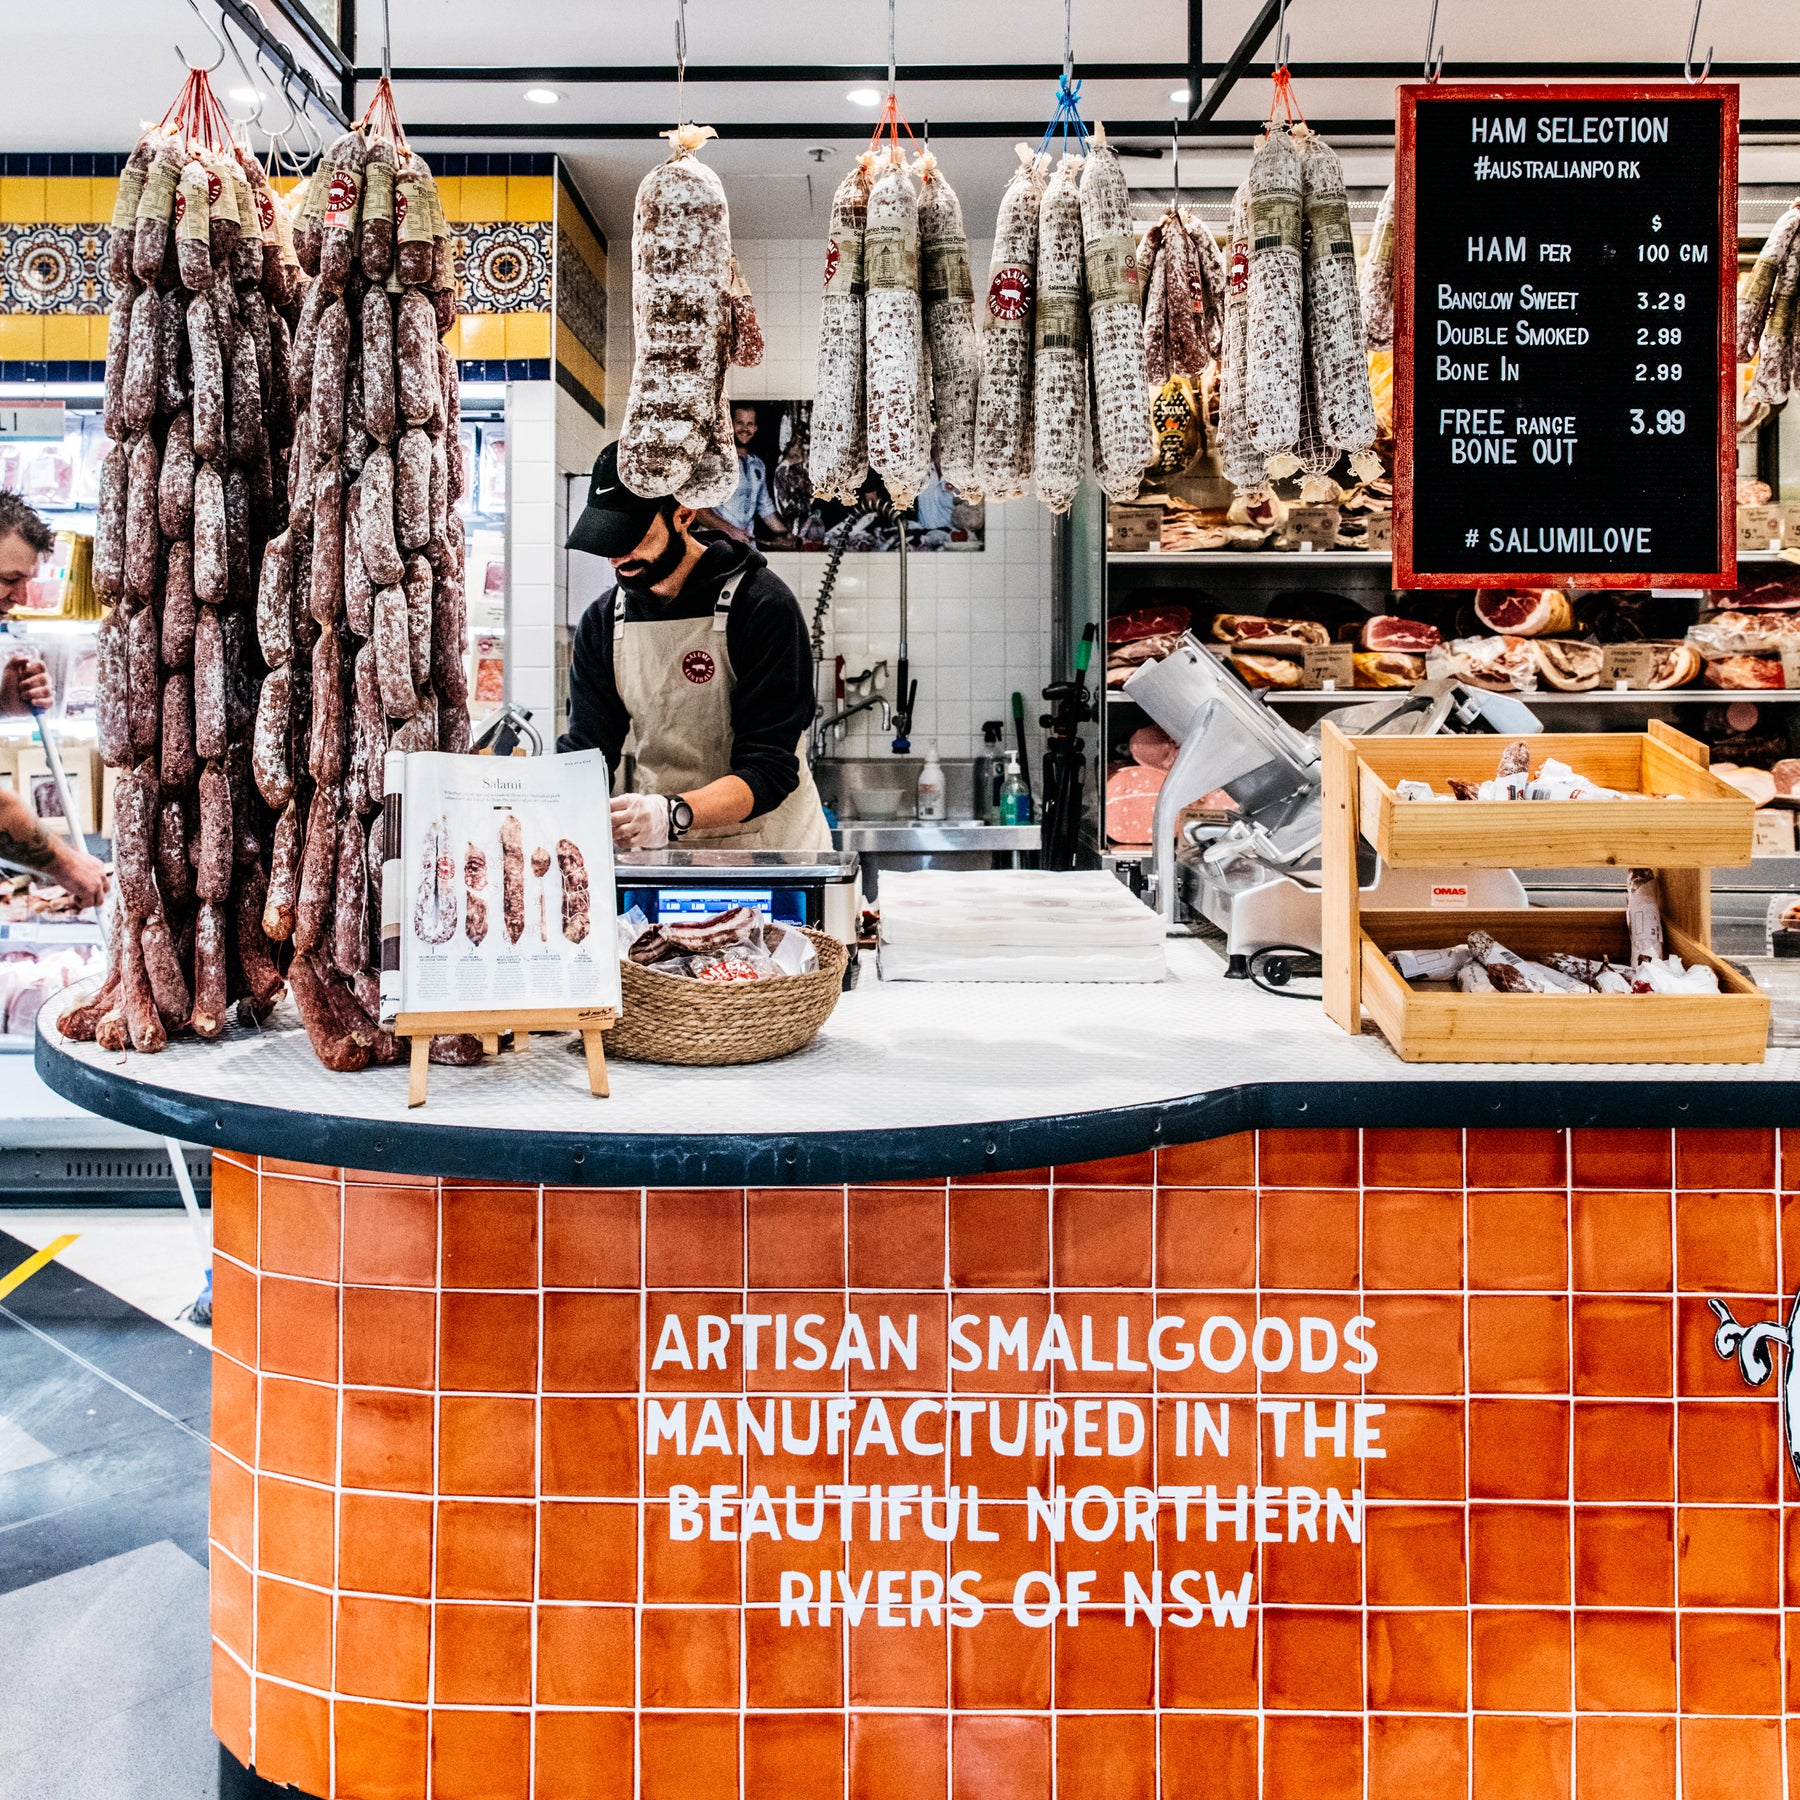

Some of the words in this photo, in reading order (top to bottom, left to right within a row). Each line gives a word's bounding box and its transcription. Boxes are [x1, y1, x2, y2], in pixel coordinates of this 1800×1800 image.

[1472, 117, 1526, 143] HAM
[1537, 117, 1668, 143] SELECTION
[1652, 215, 1662, 232] $
[1468, 237, 1526, 262] HAM
[1540, 244, 1571, 262] PER
[1639, 244, 1669, 262] 100
[1680, 244, 1708, 263] GM
[994, 268, 1031, 288] SALUMI
[989, 294, 1032, 320] AUSTRALIA
[1638, 292, 1685, 310] 3.29
[1637, 328, 1682, 345] 2.99
[1636, 364, 1682, 381] 2.99
[1440, 409, 1505, 436] FREE
[1517, 417, 1576, 436] RANGE
[1630, 409, 1685, 435] 3.99
[1452, 439, 1517, 465] BONE
[1533, 439, 1578, 465] OUT
[1490, 528, 1651, 553] SALUMILOVE
[482, 778, 522, 789] Salami
[1433, 887, 1467, 895] OMAS
[651, 1313, 918, 1371] ARTISAN
[950, 1314, 1379, 1374] SMALLGOODS
[646, 1398, 1145, 1457] MANUFACTURED
[1175, 1400, 1230, 1457] IN
[1257, 1402, 1387, 1459] THE
[669, 1484, 1000, 1542] BEAUTIFUL
[1026, 1485, 1362, 1544] NORTHERN
[780, 1570, 985, 1628] RIVERS
[1013, 1570, 1097, 1628] OF
[1123, 1569, 1254, 1629] NSW
